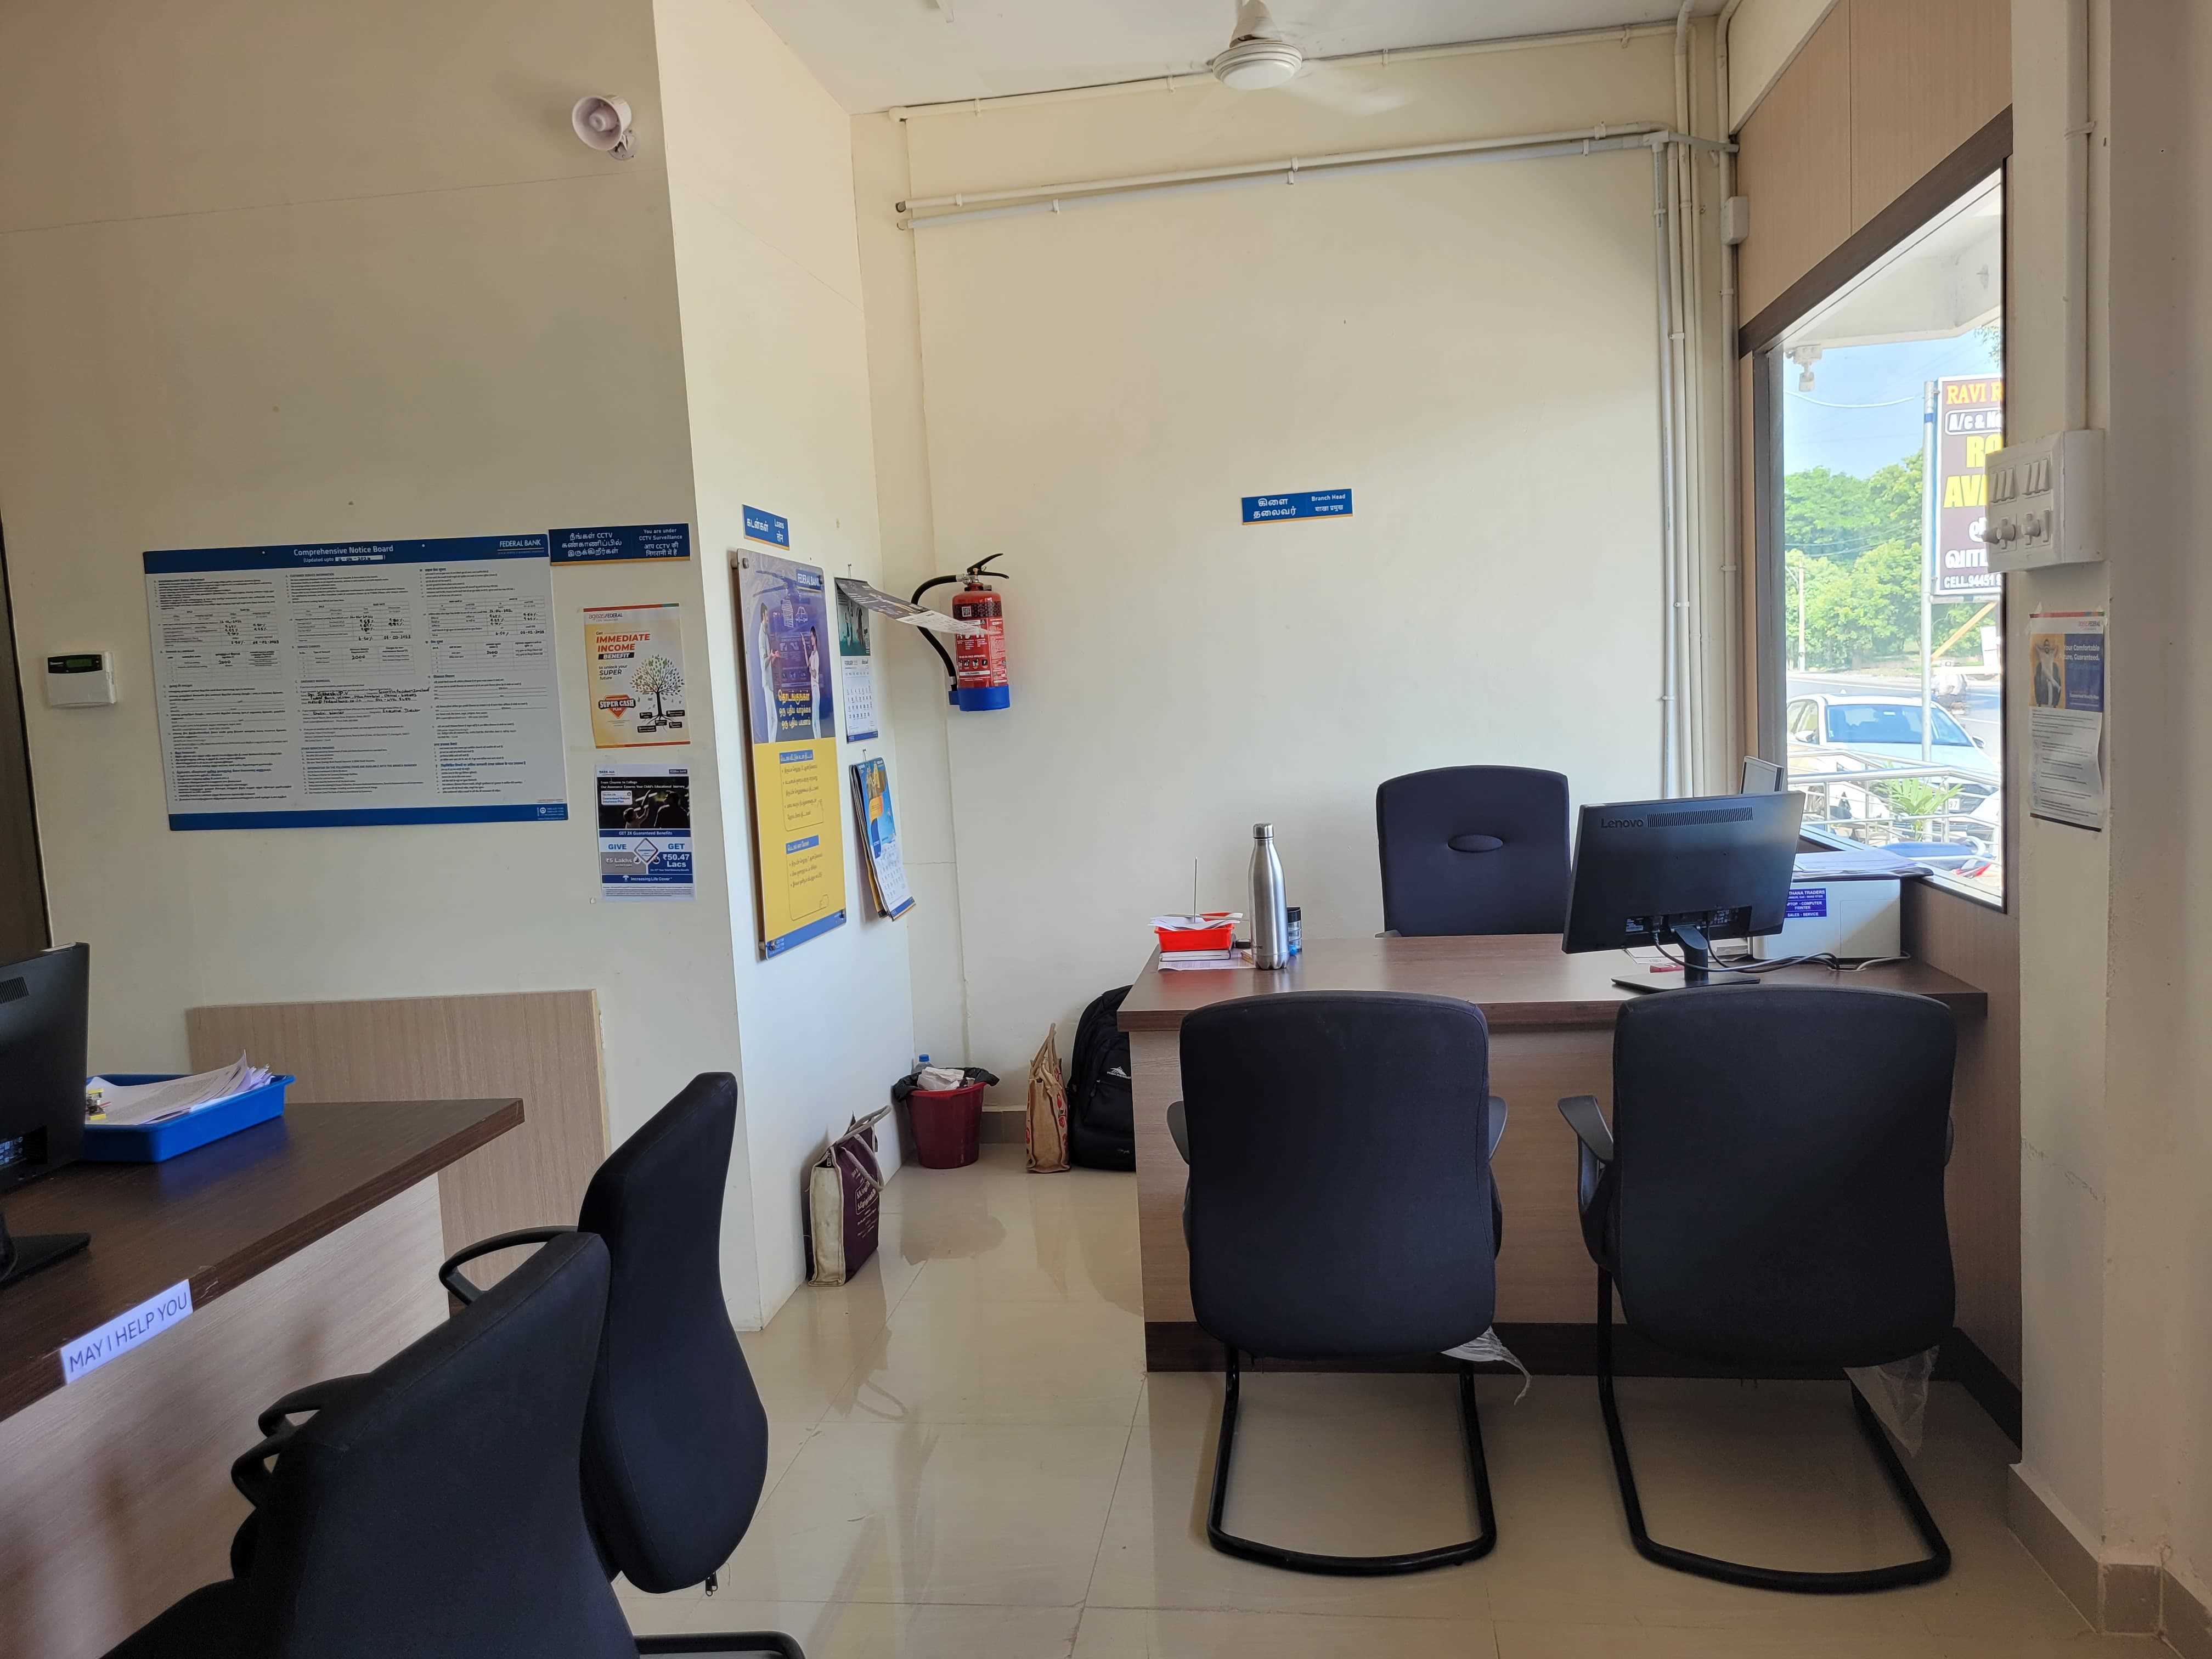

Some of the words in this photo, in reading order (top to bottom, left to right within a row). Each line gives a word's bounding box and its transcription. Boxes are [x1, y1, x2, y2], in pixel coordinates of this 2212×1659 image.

[1946, 383, 1987, 404] RAVI
[1949, 413, 1973, 431] A/c
[1258, 498, 1289, 507] கிளை
[1253, 506, 1297, 519] தலைவர்
[747, 517, 769, 532] கடன்கள்
[774, 518, 785, 529] Loans
[294, 547, 347, 556] Comprehensive
[349, 546, 371, 554] Notice
[596, 634, 651, 644] IMMEDIATE
[597, 644, 635, 652] INCOME
[1601, 819, 1644, 828] Lenovo
[70, 1339, 103, 1372] MAY
[108, 1335, 112, 1352] I
[115, 1312, 155, 1346] HELP
[157, 1292, 188, 1321] YOU
